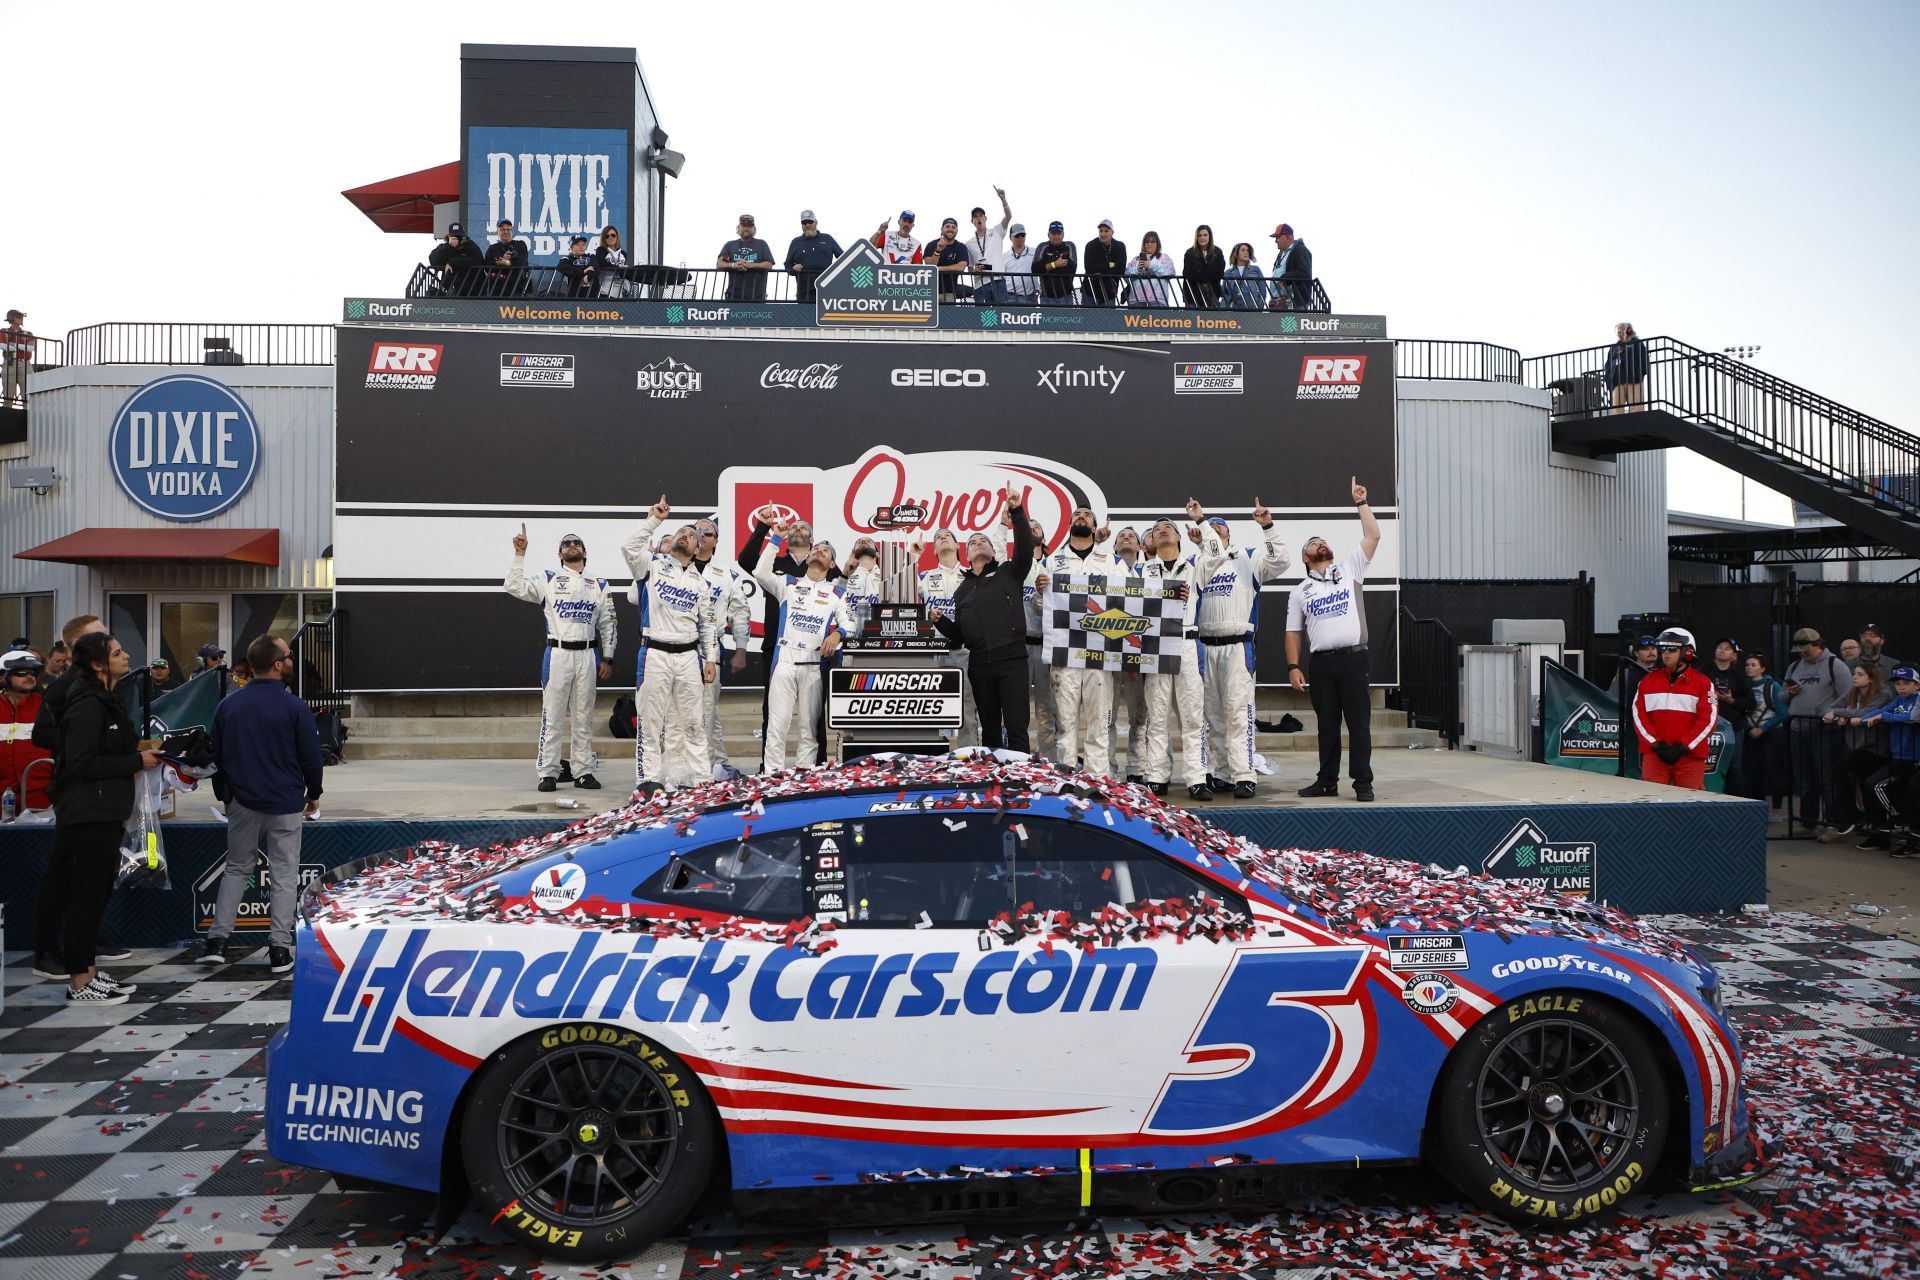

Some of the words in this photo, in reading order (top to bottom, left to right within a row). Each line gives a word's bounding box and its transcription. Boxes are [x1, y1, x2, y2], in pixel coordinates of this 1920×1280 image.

[486, 152, 610, 234] DIXIE
[878, 269, 933, 286] Ruoff
[878, 288, 932, 297] MORTGAGE
[369, 303, 412, 317] Ruoff
[413, 306, 456, 315] MORTGAGE
[499, 305, 572, 320] Welcome
[576, 306, 625, 321] home.
[822, 299, 889, 312] VICTORY
[892, 300, 933, 313] LANE
[687, 307, 730, 322] Ruoff
[730, 311, 773, 320] MORTGAGE
[1001, 311, 1043, 326] Ruoff
[1043, 315, 1084, 324] MORTGAGE
[1123, 313, 1192, 329] Welcome
[1196, 315, 1242, 330] home.
[1300, 317, 1340, 332] Ruoff
[1340, 321, 1380, 331] MORTGAGE
[373, 346, 438, 372] RR
[523, 356, 564, 368] NASCAR
[511, 370, 531, 381] CUP
[531, 370, 565, 381] SERIES
[760, 361, 843, 390] Coca-Cola
[891, 367, 987, 387] GEICO
[1196, 364, 1234, 375] NASCAR
[1304, 357, 1362, 382] RR
[366, 373, 437, 385] RICHMOND
[636, 369, 703, 392] BUSCH
[1037, 362, 1127, 394] xfinity
[1184, 377, 1203, 389] CUP
[1203, 377, 1235, 388] SERIES
[1297, 384, 1361, 395] RICHMOND
[130, 411, 239, 469] DIXIE
[147, 471, 223, 496] VODKA
[654, 579, 700, 603] Hendrick
[1060, 583, 1102, 593] TOYOTA
[1105, 585, 1153, 597] OWNERS
[553, 599, 597, 613] Hendrick
[659, 592, 695, 610] Cars.com
[1306, 588, 1350, 614] Hendrick
[1313, 601, 1349, 617] Cars.com
[788, 612, 825, 626] Hendrick
[881, 620, 917, 632] WINNER
[1084, 616, 1148, 632] SUNOCO
[1075, 649, 1108, 661] APRIL
[872, 674, 943, 691] NASCAR
[848, 699, 883, 716] CUP
[883, 699, 944, 716] SERIES
[1563, 739, 1600, 749] VICTORY
[1540, 846, 1591, 864] Ruoff
[1540, 865, 1591, 875] MORTGAGE
[1553, 877, 1591, 889] LANE
[535, 886, 577, 901] VALVOLINE
[818, 893, 843, 905] MAC
[1412, 938, 1453, 948] NASCAR
[1401, 953, 1421, 963] CUP
[1422, 952, 1457, 963] SERIES
[1408, 974, 1433, 988] NASCAR
[1409, 997, 1454, 1014] ANNIVERSARY
[1507, 995, 1583, 1024] EAGLE
[1138, 945, 1377, 1136] 5
[286, 1082, 424, 1124] HIRING
[284, 1123, 421, 1150] TECHNICIANS
[503, 1203, 583, 1248] EAGLE
